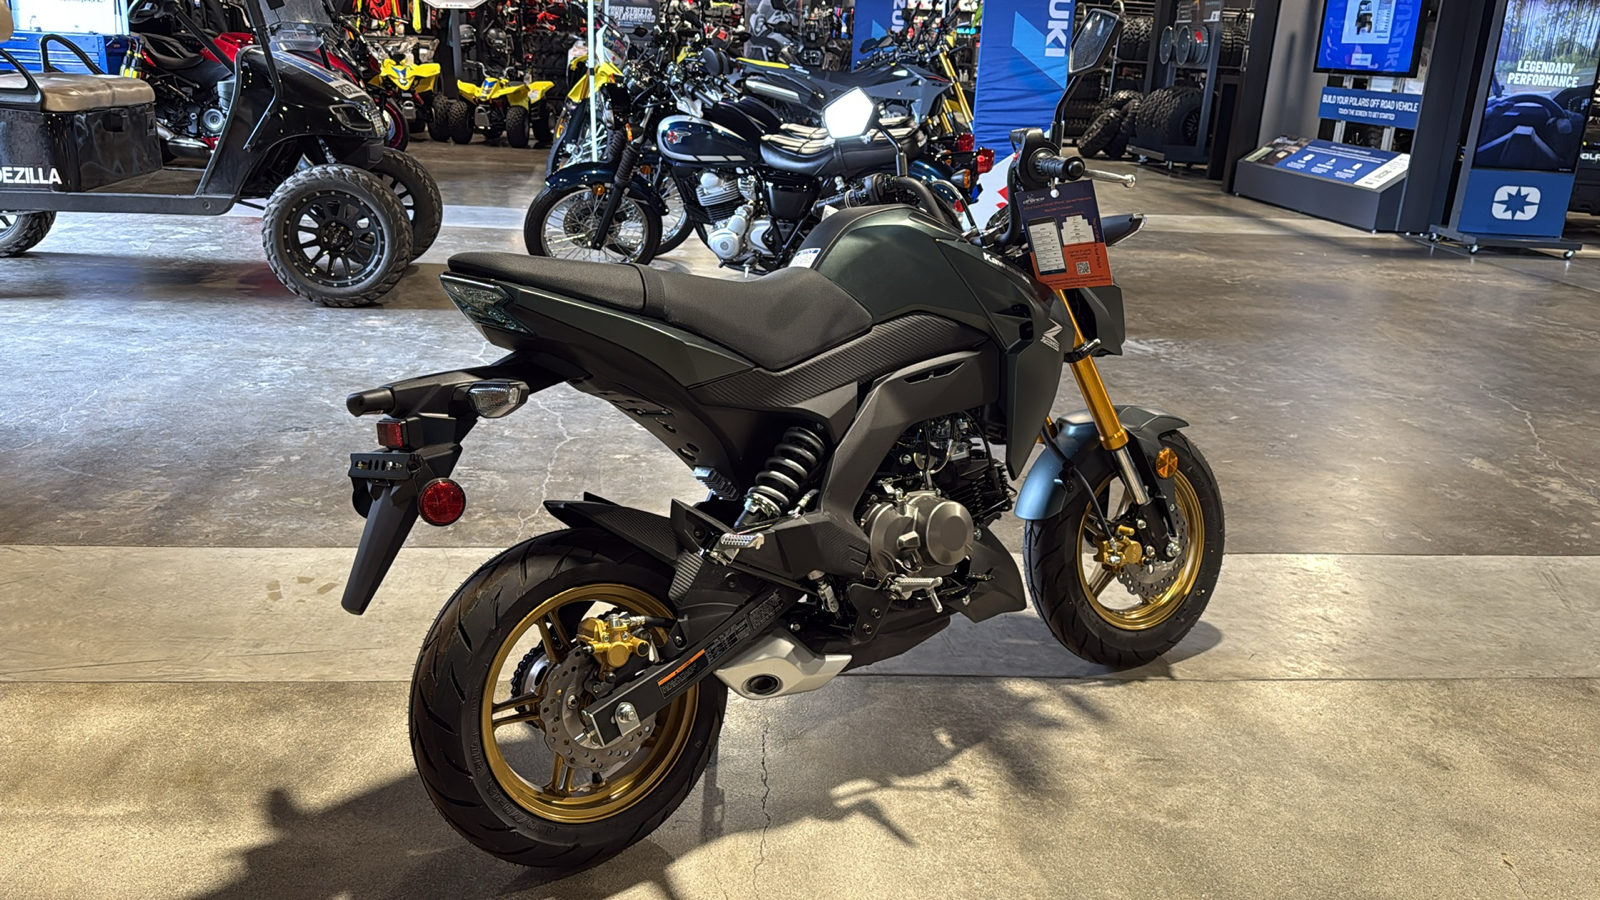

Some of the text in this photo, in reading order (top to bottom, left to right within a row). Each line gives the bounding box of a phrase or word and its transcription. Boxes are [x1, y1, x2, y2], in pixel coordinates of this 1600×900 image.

[625, 6, 653, 15] STREETS
[1517, 60, 1575, 75] LEGENDARY
[1507, 73, 1579, 88] PERFORMANCE
[1322, 94, 1419, 112] BUILD YOUR POLARIS OFF ROAD VEHICLE
[0, 166, 62, 185] EZILLA
